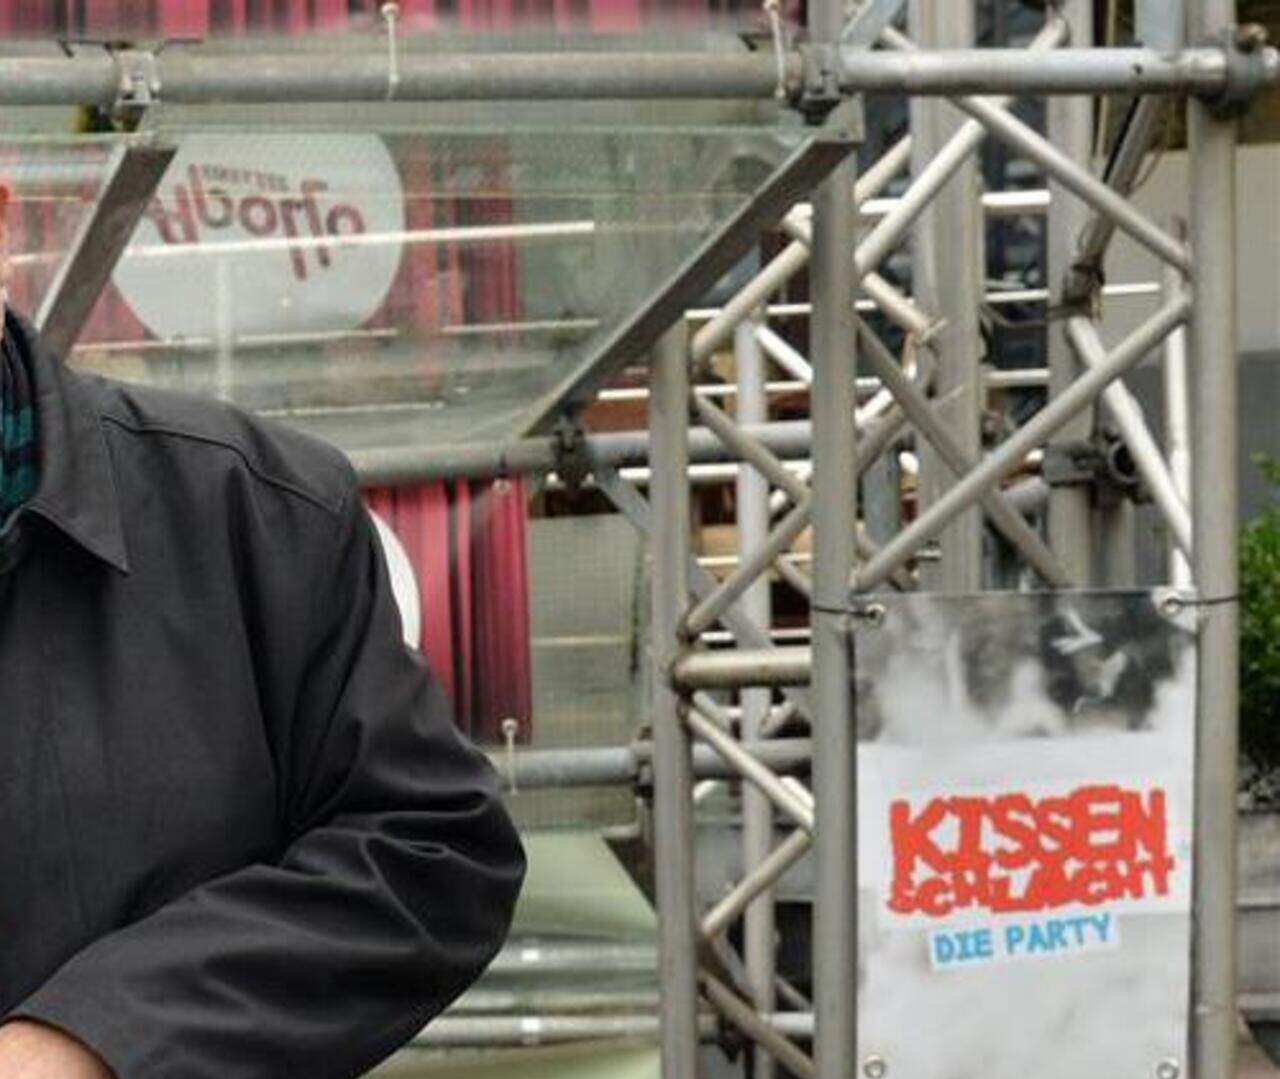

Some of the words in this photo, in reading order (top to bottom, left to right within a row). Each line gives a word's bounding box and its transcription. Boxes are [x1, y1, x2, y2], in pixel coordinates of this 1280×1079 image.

[889, 785, 1168, 885] KISSEN
[933, 928, 995, 965] DIE
[1005, 912, 1113, 955] PARTY
